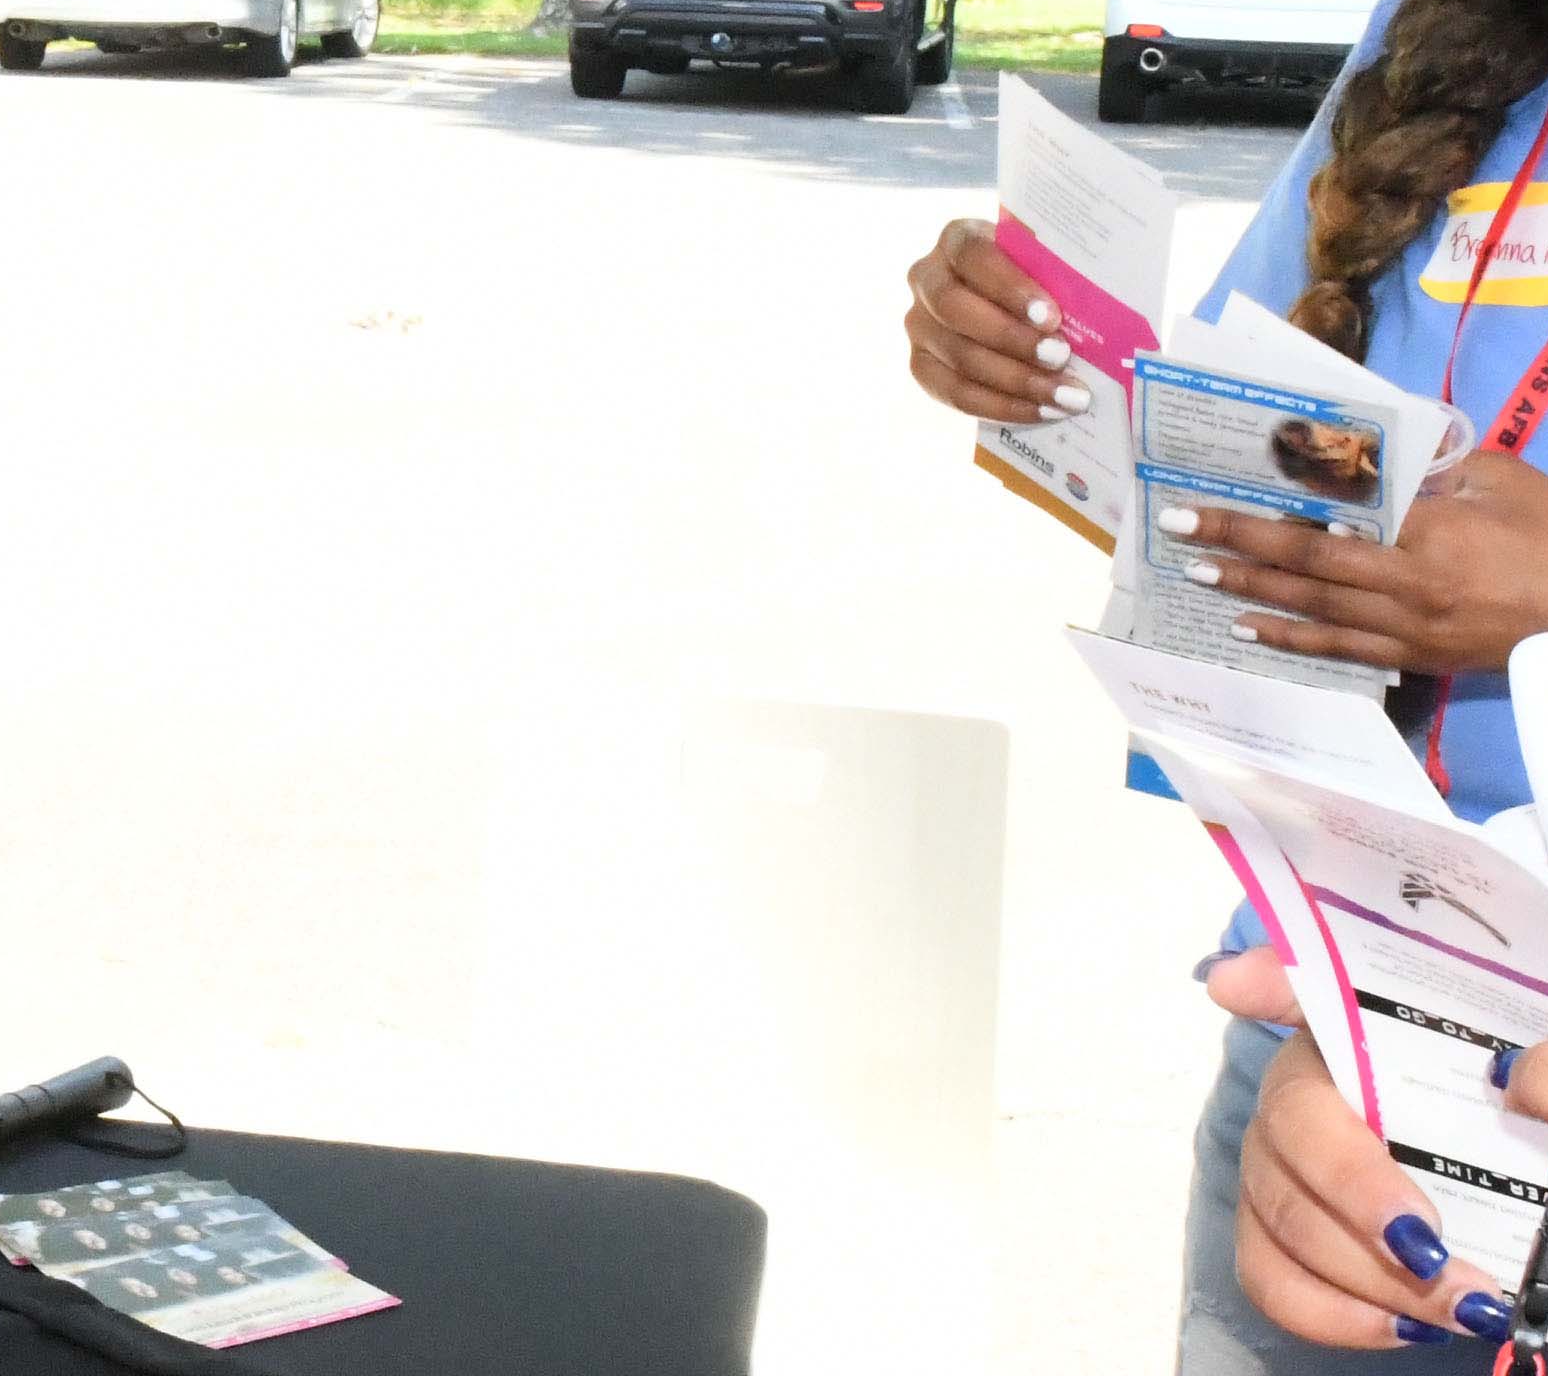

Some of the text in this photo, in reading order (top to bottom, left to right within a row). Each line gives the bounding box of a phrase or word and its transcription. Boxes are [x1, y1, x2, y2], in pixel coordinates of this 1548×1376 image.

[1452, 221, 1535, 265] Brenna
[1244, 387, 1317, 413] EFFECTS
[1498, 397, 1536, 449] AFB
[999, 426, 1056, 474] Robins
